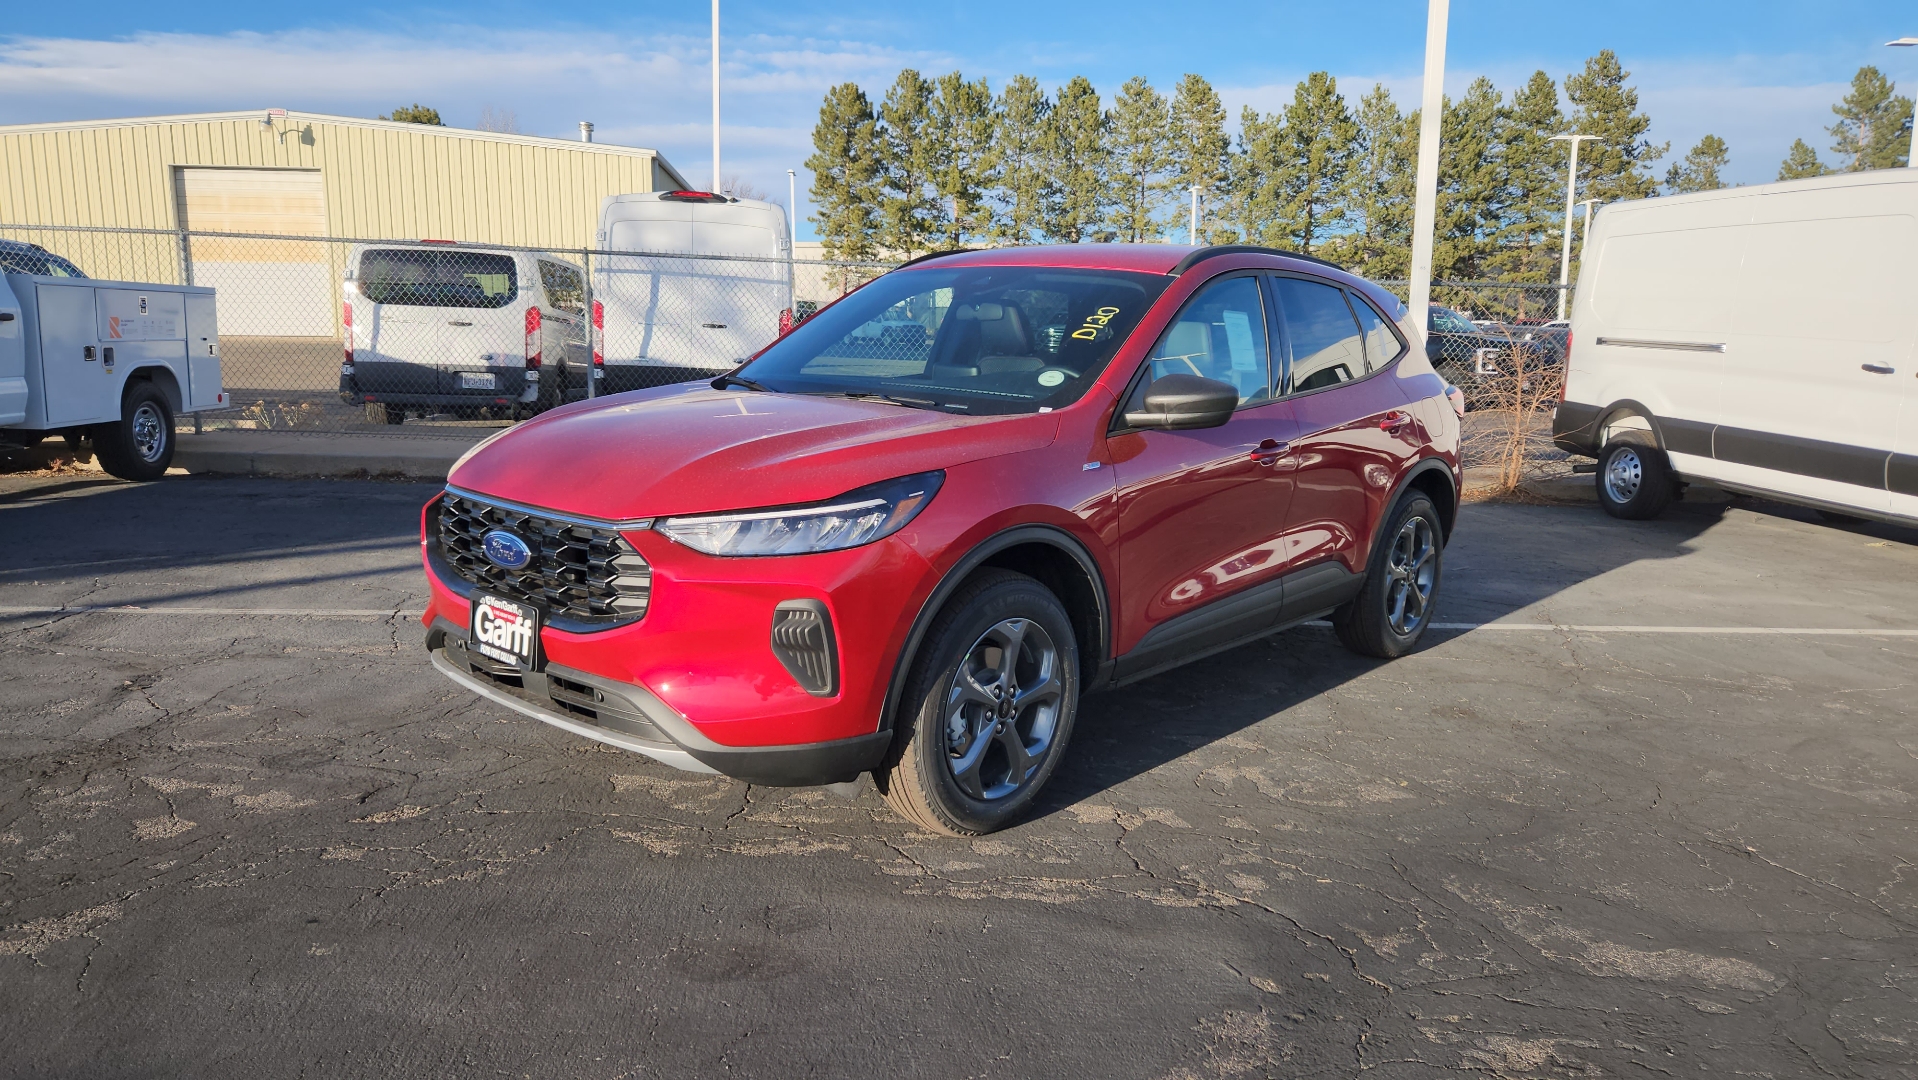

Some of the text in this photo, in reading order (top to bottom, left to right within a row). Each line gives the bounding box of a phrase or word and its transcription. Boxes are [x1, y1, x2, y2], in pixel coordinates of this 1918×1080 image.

[1072, 306, 1120, 340] D120
[491, 538, 518, 561] Ford
[474, 604, 532, 657] Garff
